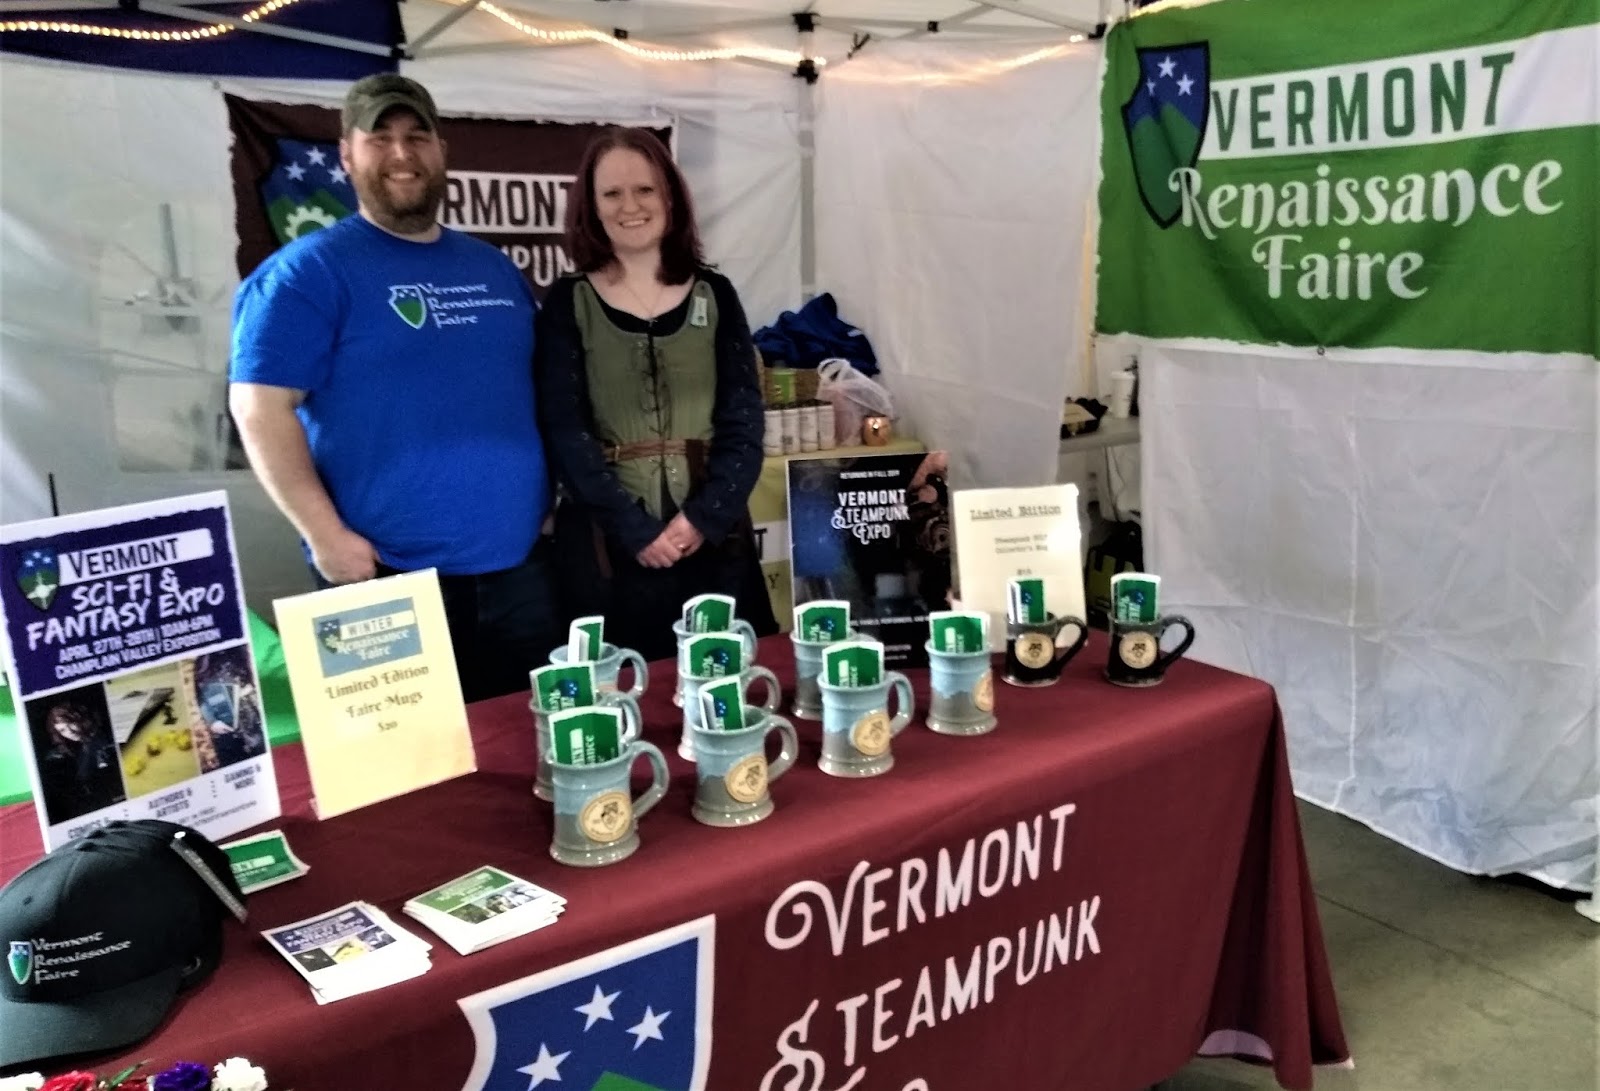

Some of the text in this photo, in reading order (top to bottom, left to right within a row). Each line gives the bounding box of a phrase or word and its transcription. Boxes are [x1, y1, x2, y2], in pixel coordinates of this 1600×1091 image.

[1212, 51, 1516, 152] VERMONT
[1168, 159, 1565, 240] Renaissance
[1252, 234, 1429, 300] Faire
[417, 282, 488, 296] Vermont
[432, 312, 479, 329] Faire
[838, 488, 906, 507] VERMONT
[831, 505, 911, 529] STEAMPUNK
[970, 507, 1013, 520] Limited
[852, 522, 891, 545] EXPO
[68, 538, 179, 578] VERMONT
[71, 567, 180, 612] SCI-FI &
[26, 583, 225, 651] FANTASY EXPO
[347, 616, 393, 636] WINTER
[55, 628, 222, 680] CHAMPLAIN VALLEY EXPOSITION
[325, 666, 430, 699] Limited Edition
[346, 691, 423, 719] Faire Mugs
[764, 803, 1076, 957] VERMONT
[31, 931, 104, 951] Vermont
[34, 940, 132, 969] Renaissance
[34, 969, 80, 985] Faire
[757, 895, 1102, 1091] STEAMPUNK
